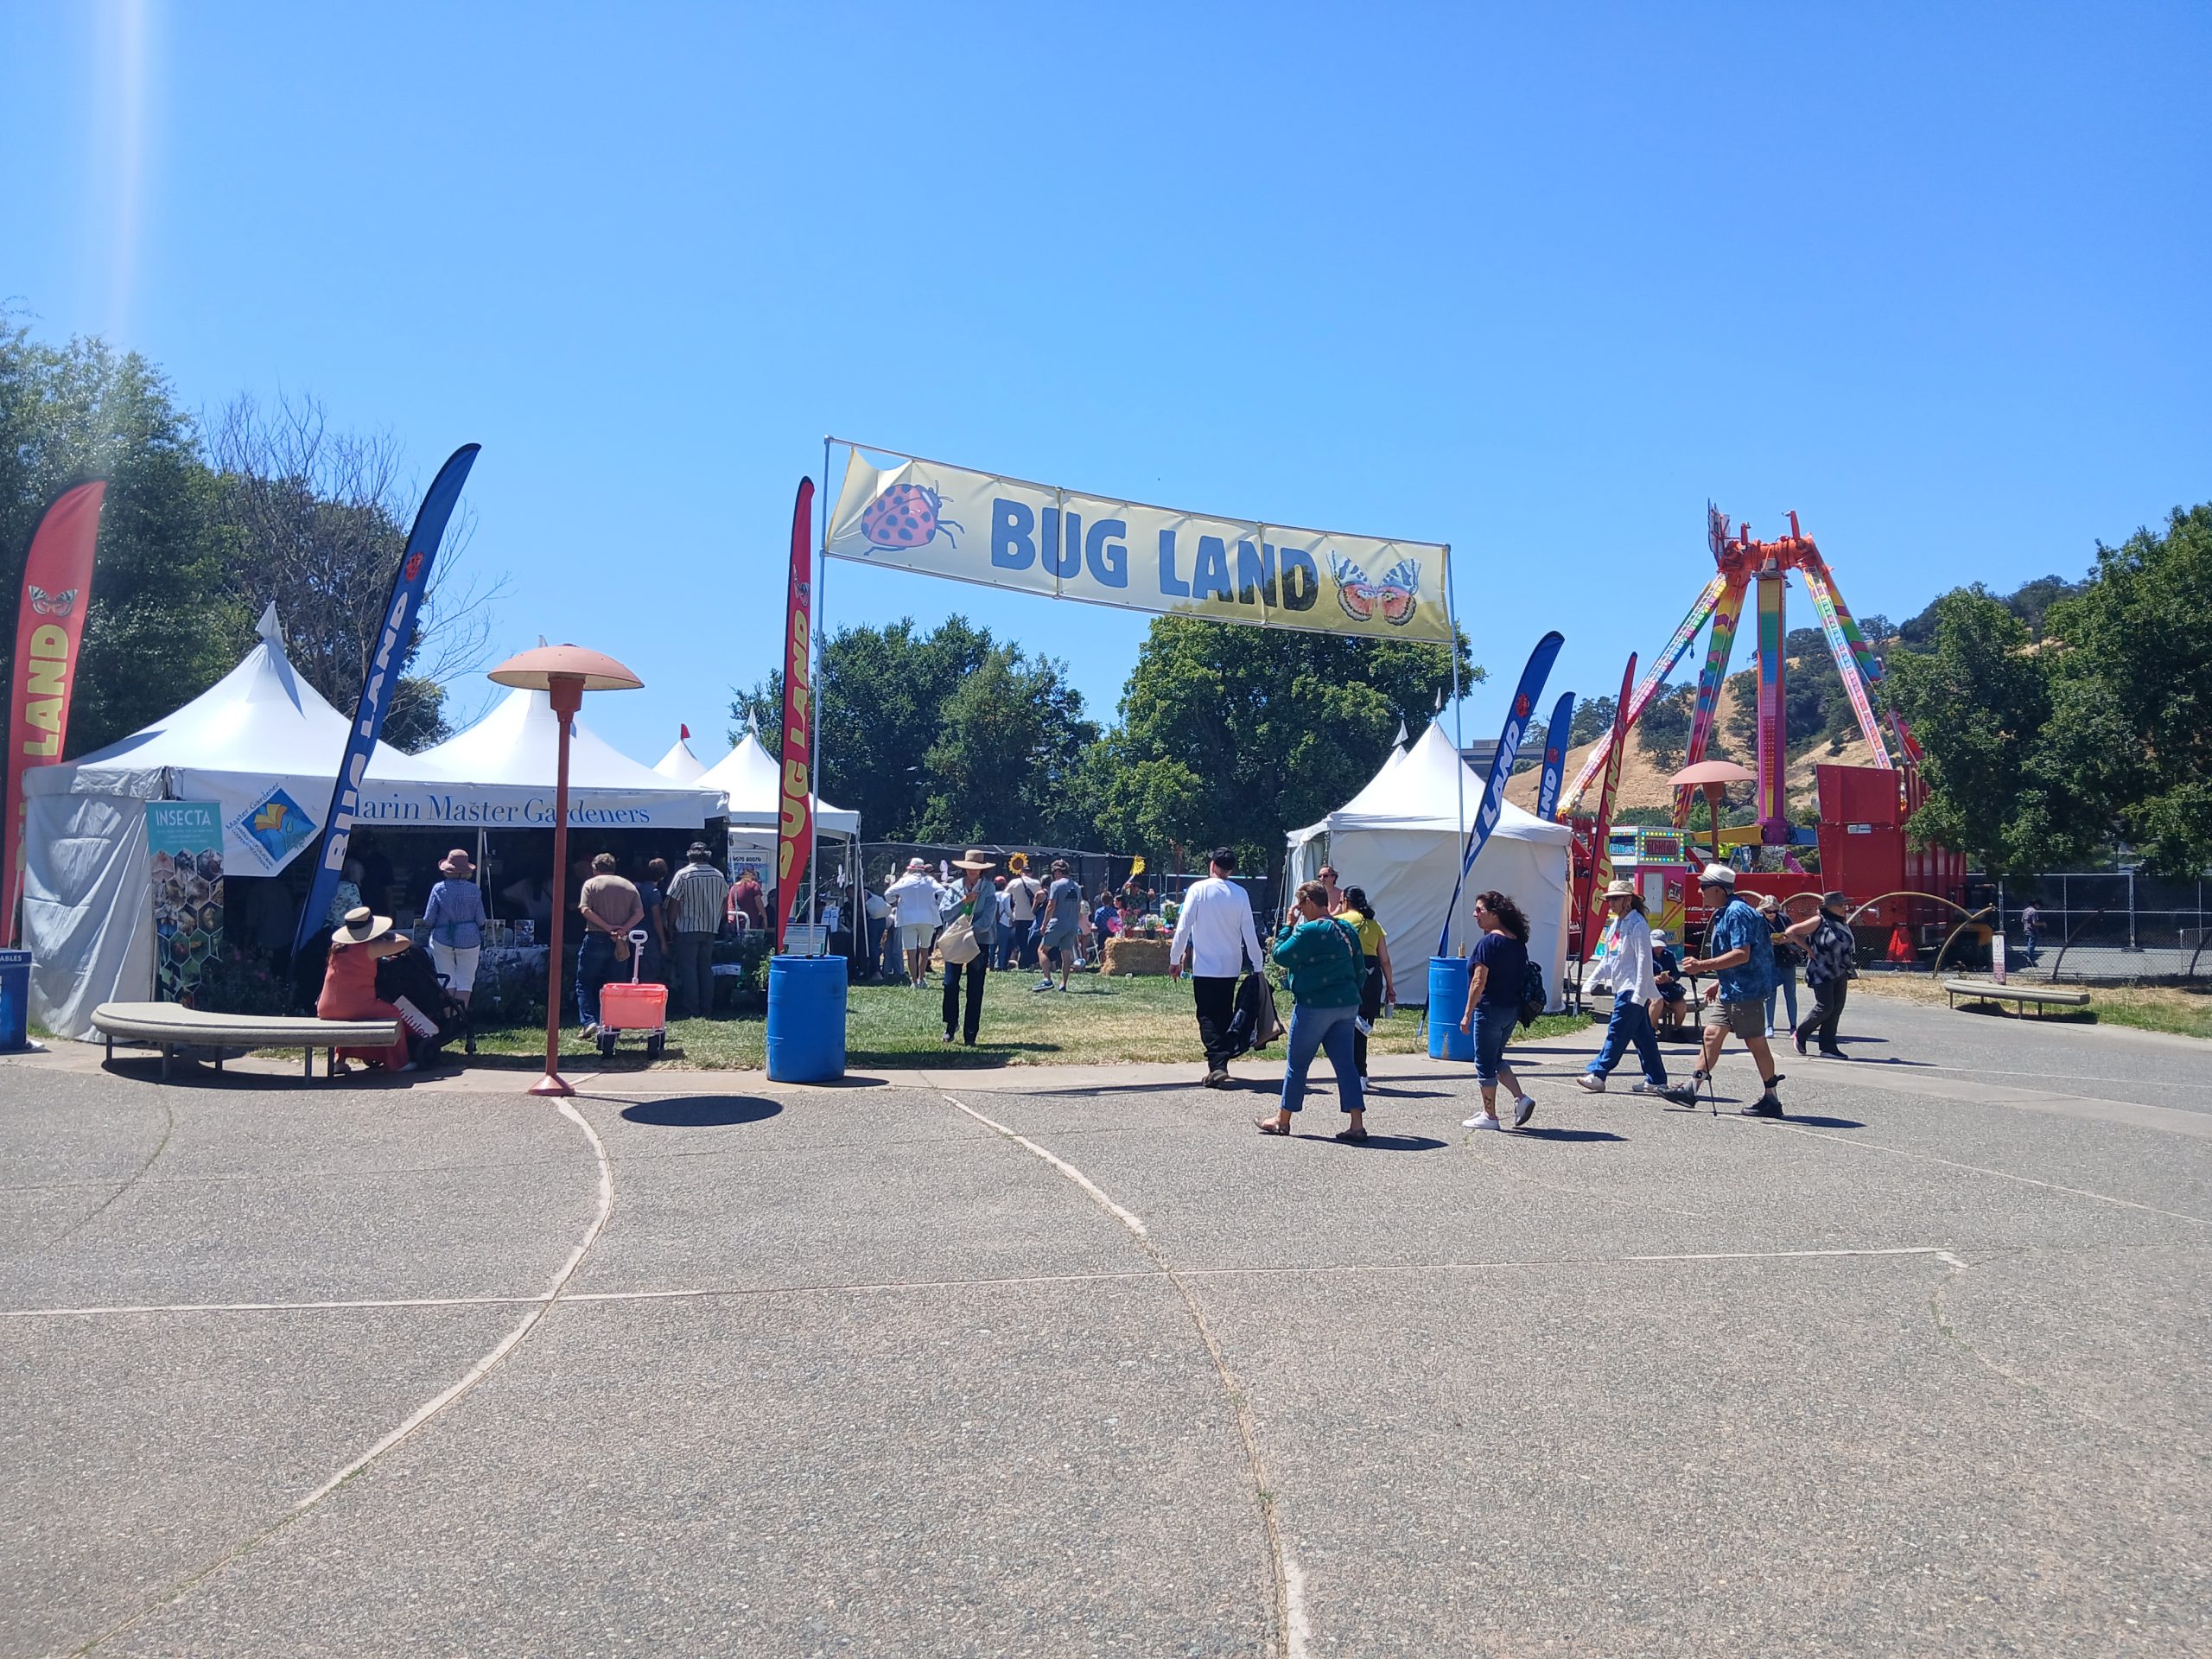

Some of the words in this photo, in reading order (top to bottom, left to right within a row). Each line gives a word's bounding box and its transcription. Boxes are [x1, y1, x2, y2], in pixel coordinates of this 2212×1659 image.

[991, 498, 1128, 588] BUG
[1159, 530, 1319, 612] LAND
[23, 623, 69, 757] LAND
[156, 810, 211, 826] INSECTA
[226, 808, 250, 830] Master
[249, 782, 280, 810] Gardener
[524, 798, 651, 823] Gadeners
